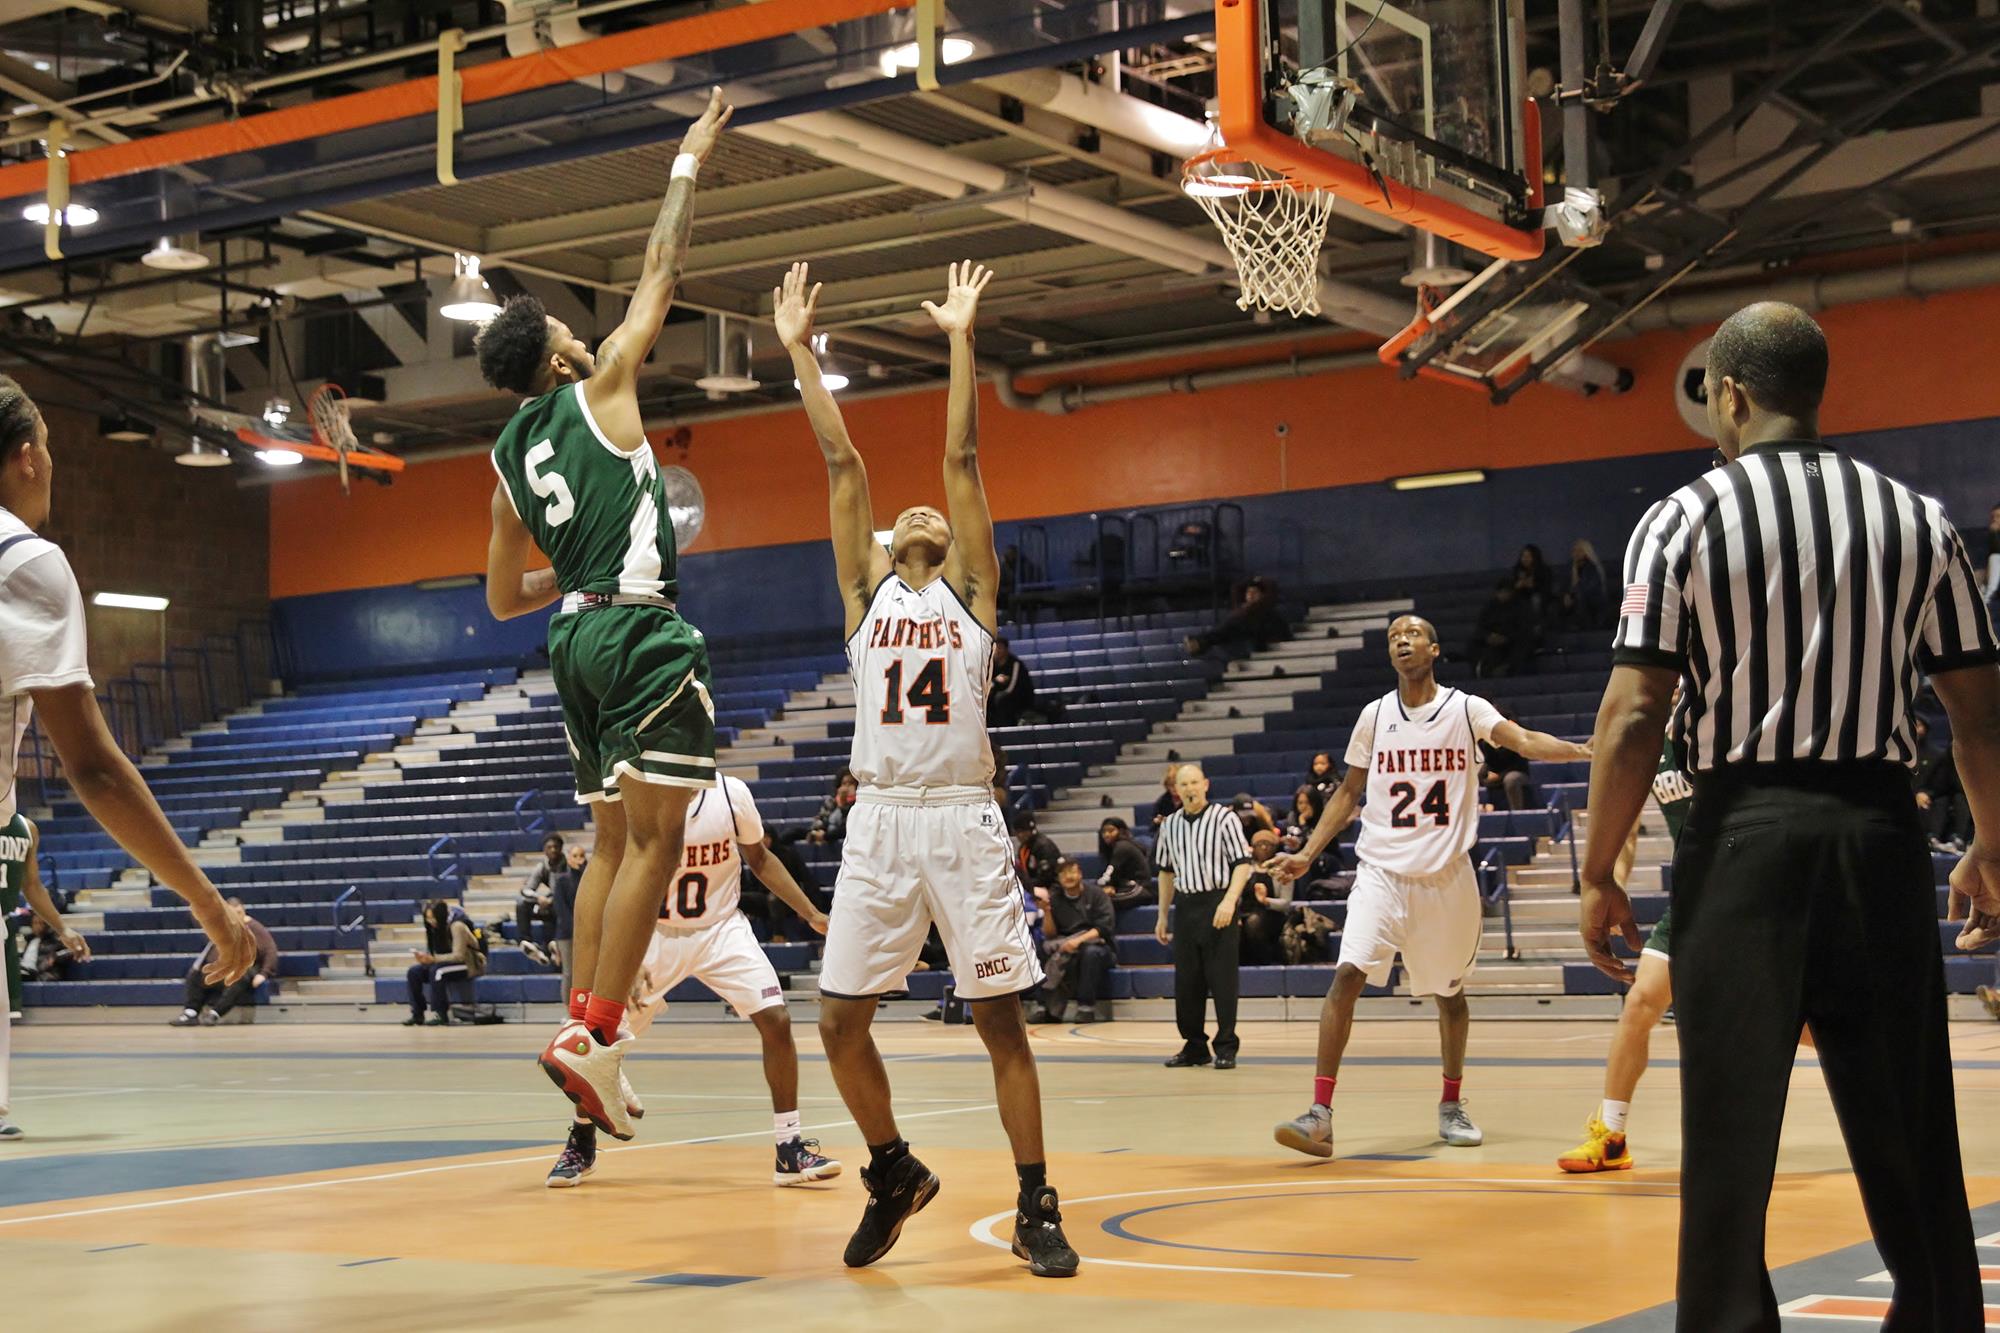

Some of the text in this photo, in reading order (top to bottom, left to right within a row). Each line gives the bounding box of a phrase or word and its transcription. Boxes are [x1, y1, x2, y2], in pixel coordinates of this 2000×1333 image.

[525, 438, 575, 527] 5
[870, 616, 962, 649] PANTHES
[880, 657, 950, 725] 14
[1377, 748, 1466, 774] PANTHERS
[1389, 779, 1450, 828] 24
[680, 839, 730, 868] HERS
[974, 956, 1012, 979] BMCC
